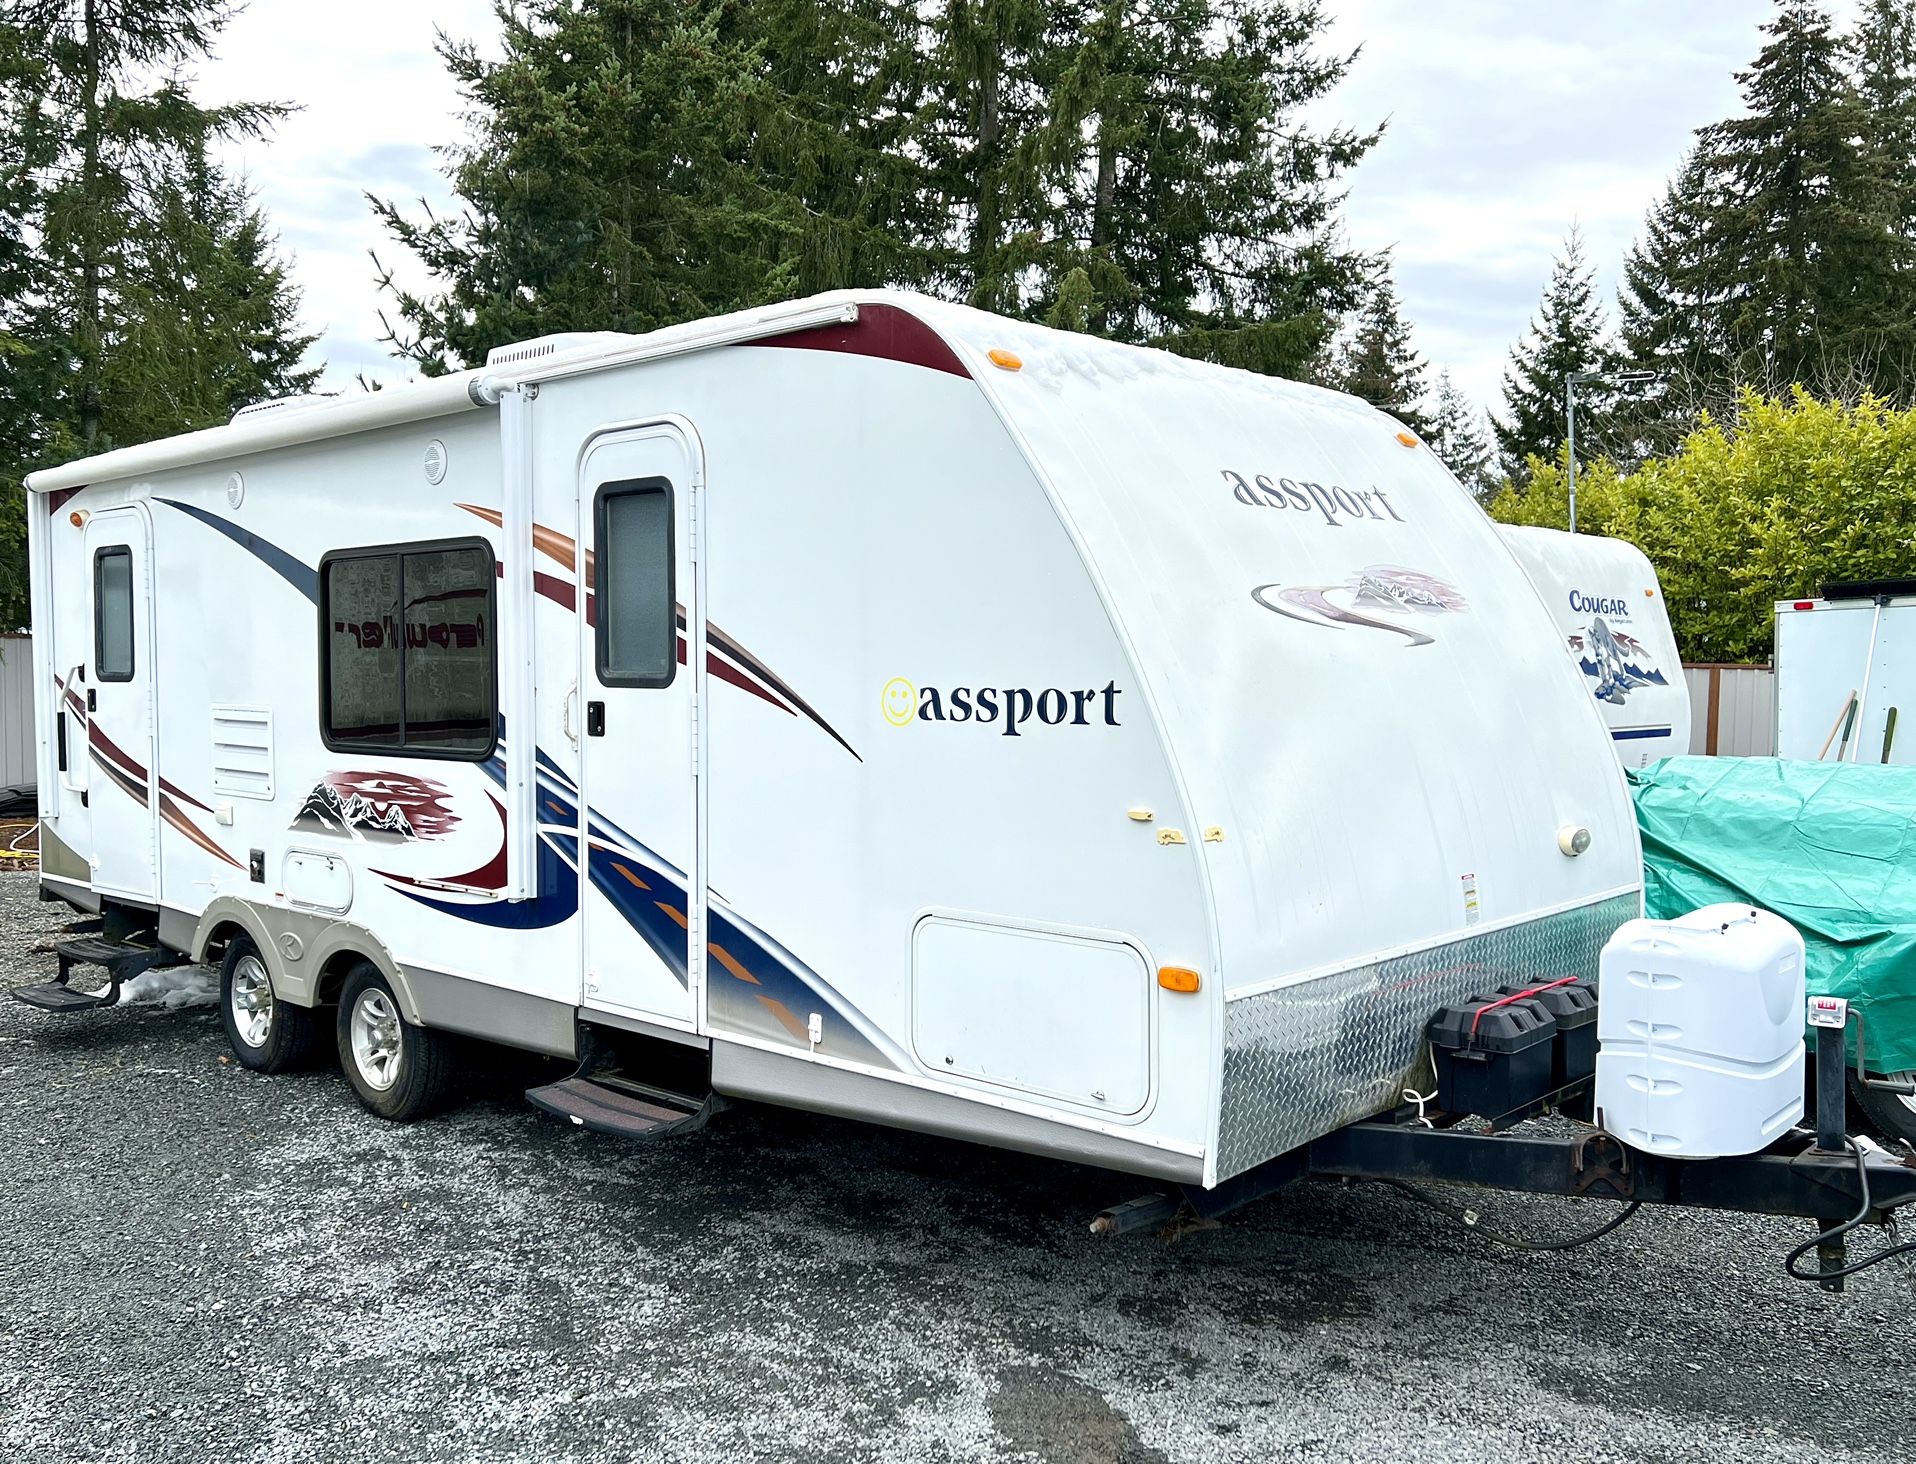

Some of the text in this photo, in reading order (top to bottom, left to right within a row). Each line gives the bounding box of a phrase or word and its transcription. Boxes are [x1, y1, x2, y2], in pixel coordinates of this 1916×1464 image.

[1220, 469, 1407, 527] assport
[1569, 589, 1629, 616] COUGAR
[917, 679, 1123, 737] assport
